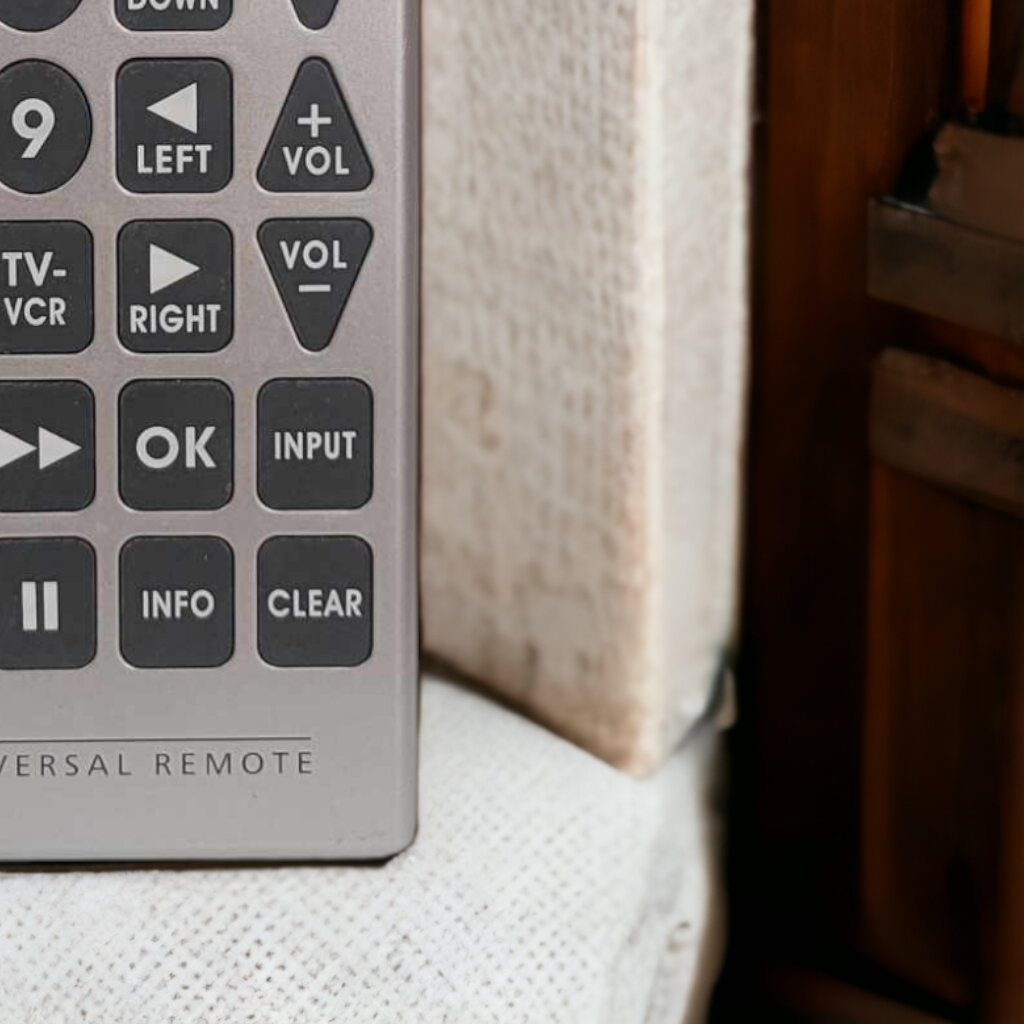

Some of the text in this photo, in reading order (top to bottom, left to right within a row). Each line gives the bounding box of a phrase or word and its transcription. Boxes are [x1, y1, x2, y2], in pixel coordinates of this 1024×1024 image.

[12, 99, 54, 158] 9
[138, 145, 211, 173] LEFT
[283, 146, 349, 175] VOL
[280, 240, 346, 269] VOL
[2, 252, 66, 286] TV-
[4, 298, 65, 325] VCR
[131, 305, 220, 332] RIGHT
[136, 427, 215, 468] OK
[275, 432, 356, 459] INPUT
[143, 590, 214, 618] INFO
[268, 589, 361, 617] CLEAR
[156, 752, 311, 775] REMOTE
